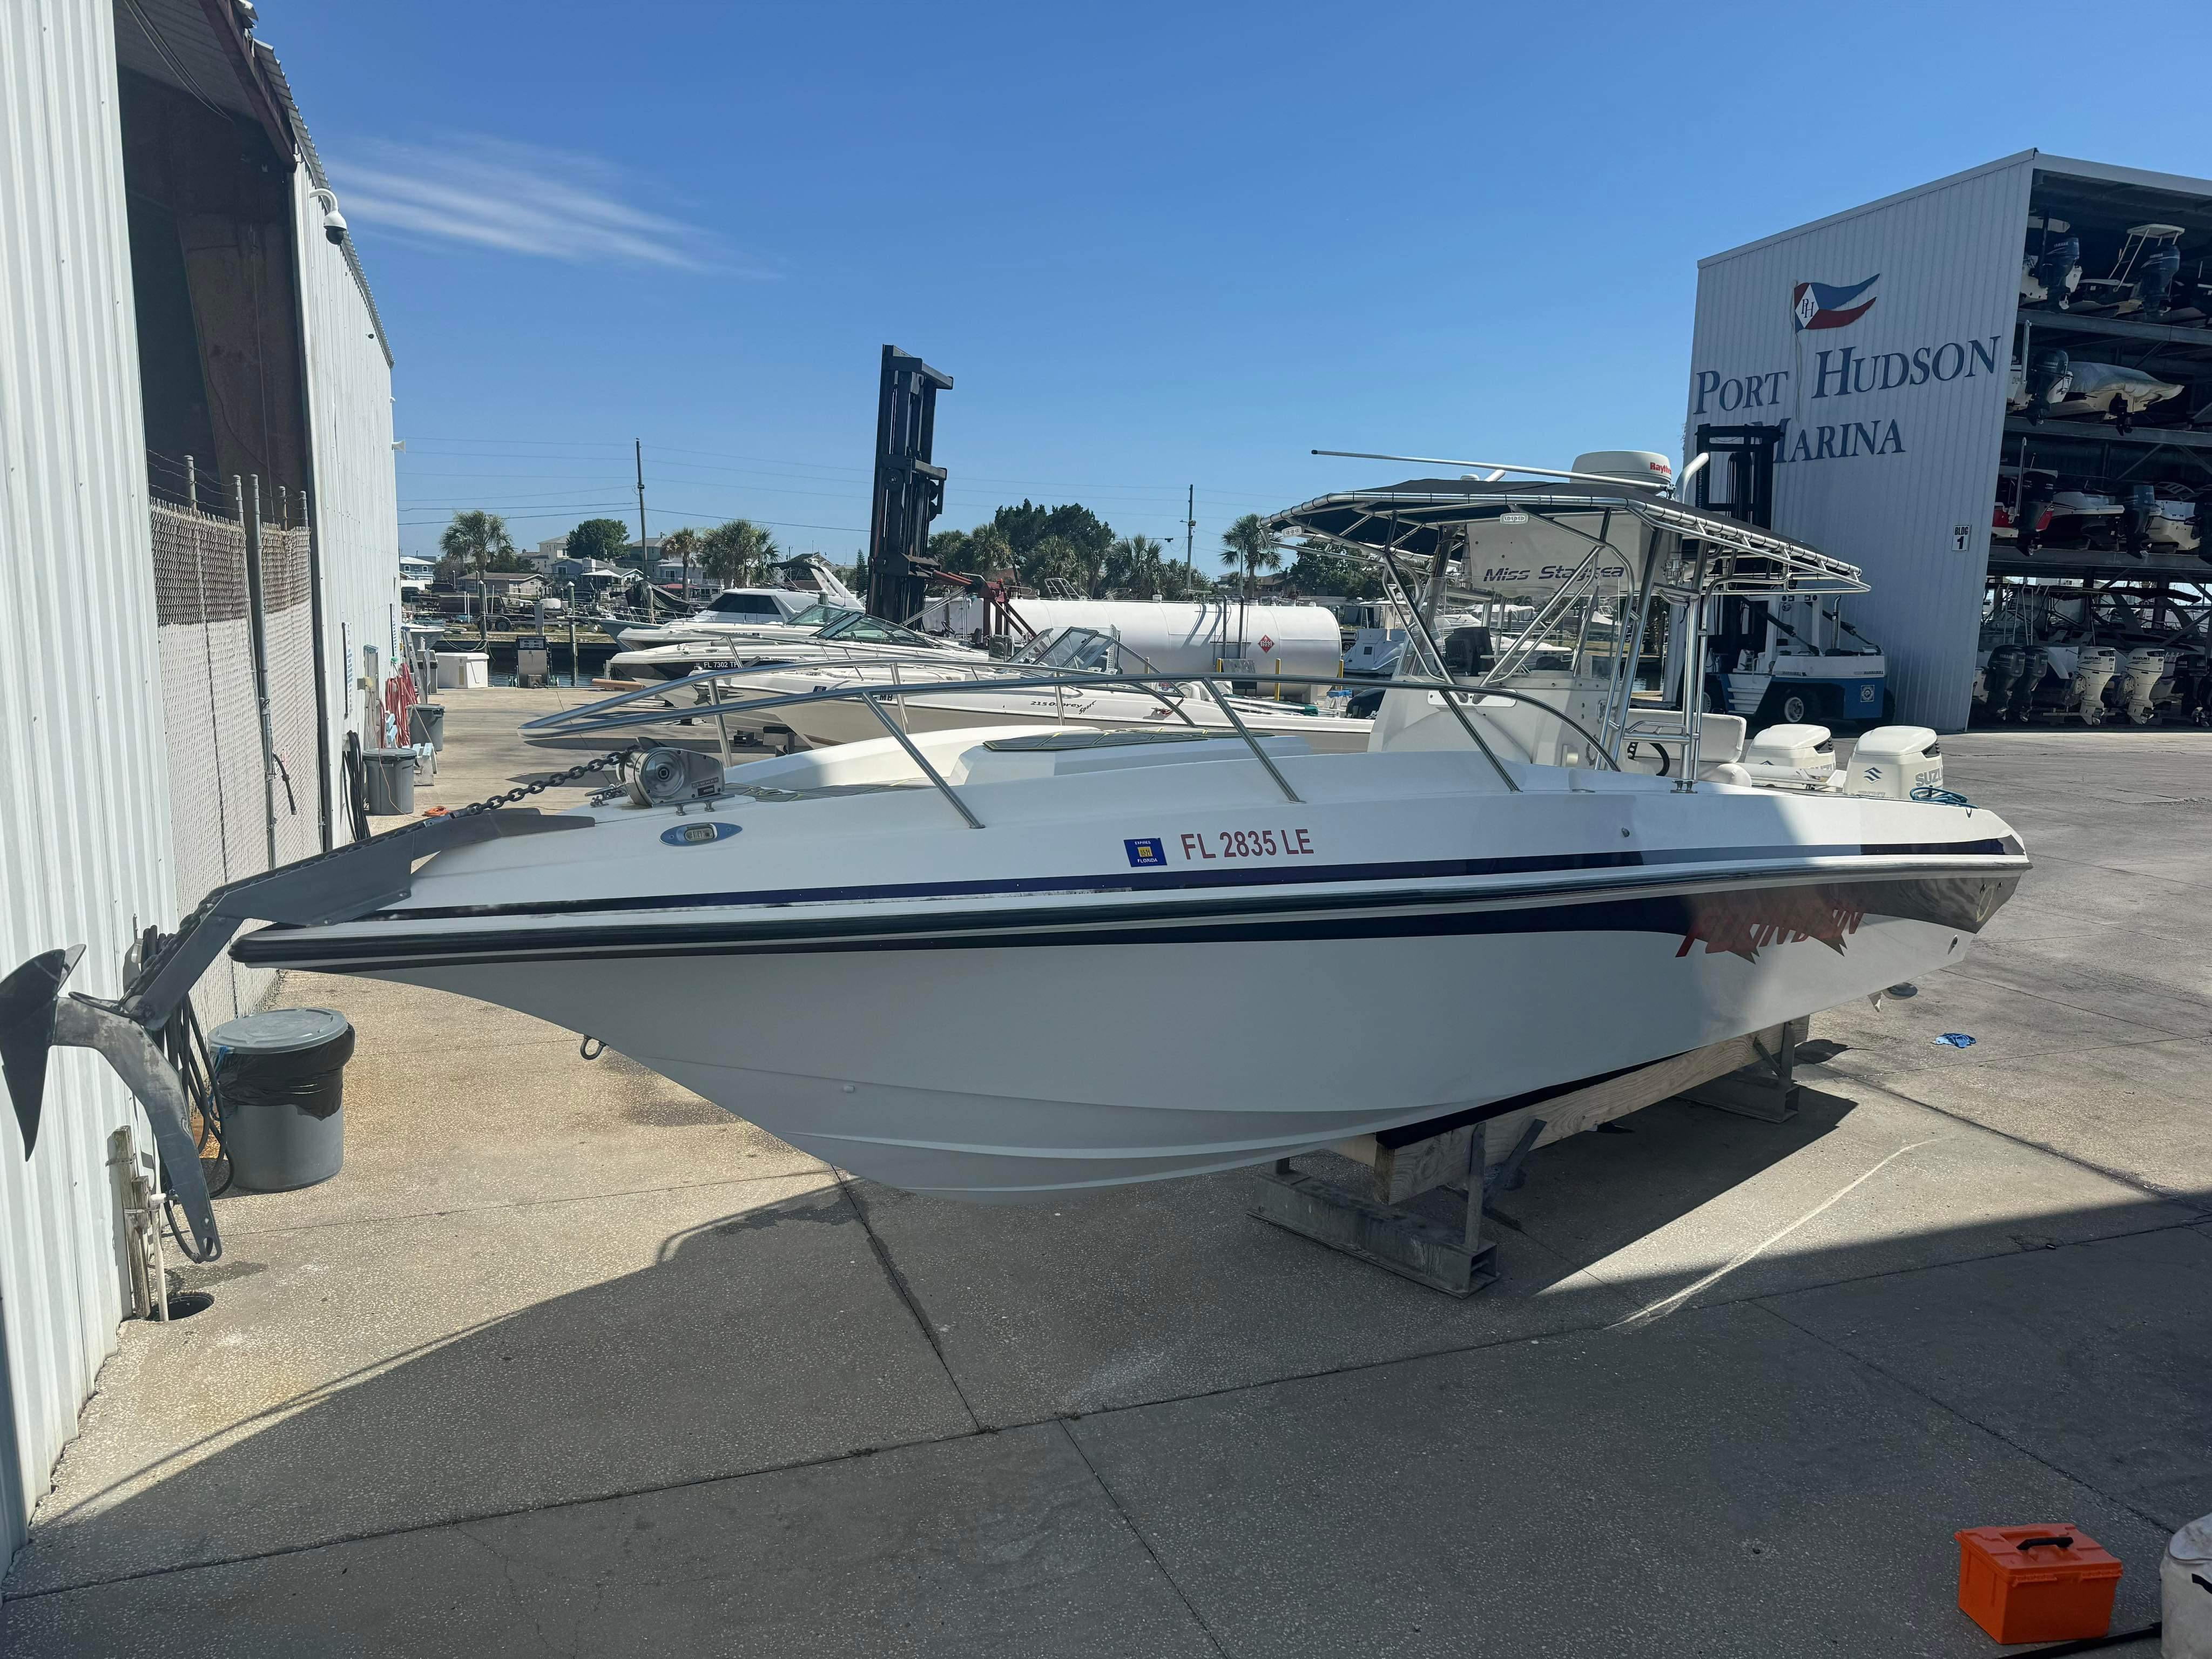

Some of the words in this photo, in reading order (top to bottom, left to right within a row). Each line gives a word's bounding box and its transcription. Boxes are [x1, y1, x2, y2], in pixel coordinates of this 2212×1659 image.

[1801, 298, 1815, 318] PH
[1693, 370, 1789, 415] PORT
[1811, 335, 2001, 399] HUDSON
[1954, 526, 1968, 535] BLDG
[1957, 535, 1965, 550] 1
[1483, 567, 1530, 582] Miss
[1078, 700, 1097, 715] Sport
[1181, 833, 1216, 860] FL
[1219, 830, 1277, 858] 2835
[1280, 828, 1314, 855] LE
